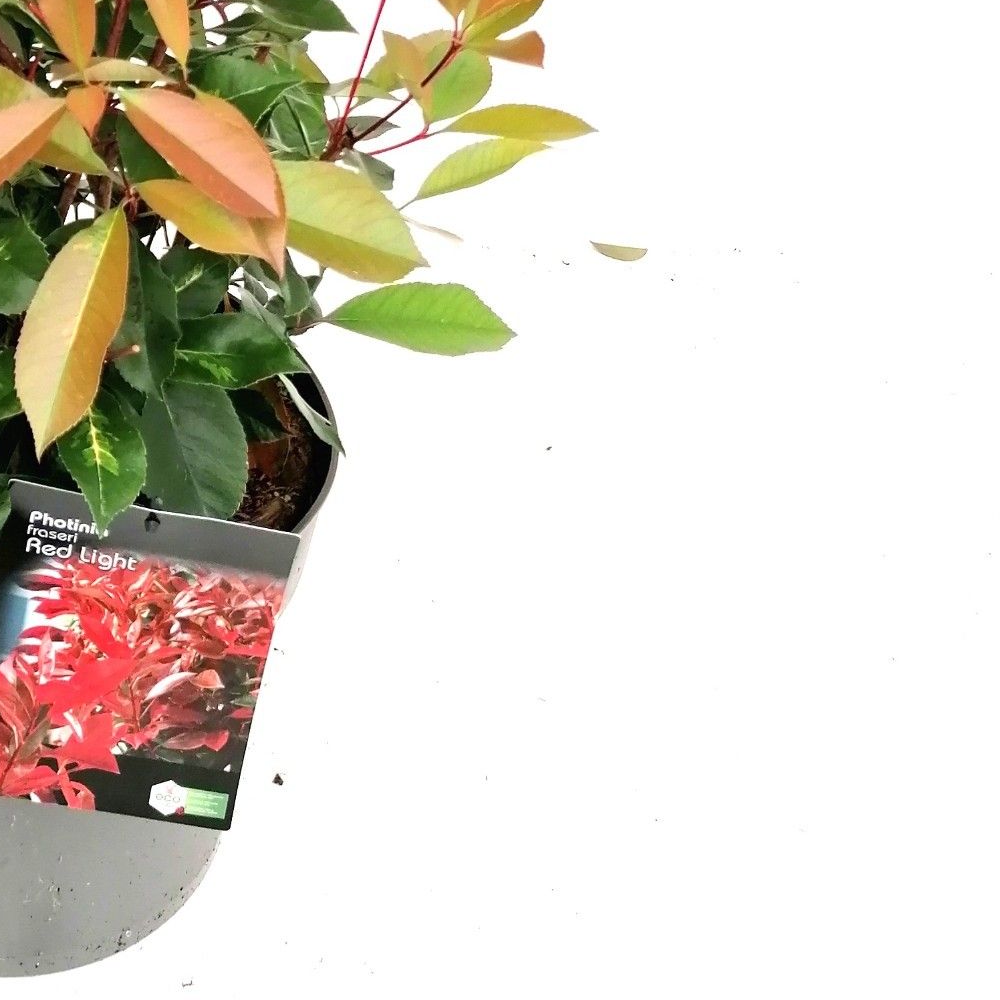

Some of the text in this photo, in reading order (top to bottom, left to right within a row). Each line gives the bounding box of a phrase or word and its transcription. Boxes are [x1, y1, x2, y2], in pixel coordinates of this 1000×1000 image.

[26, 524, 78, 543] fraseri
[26, 537, 138, 571] Red Light
